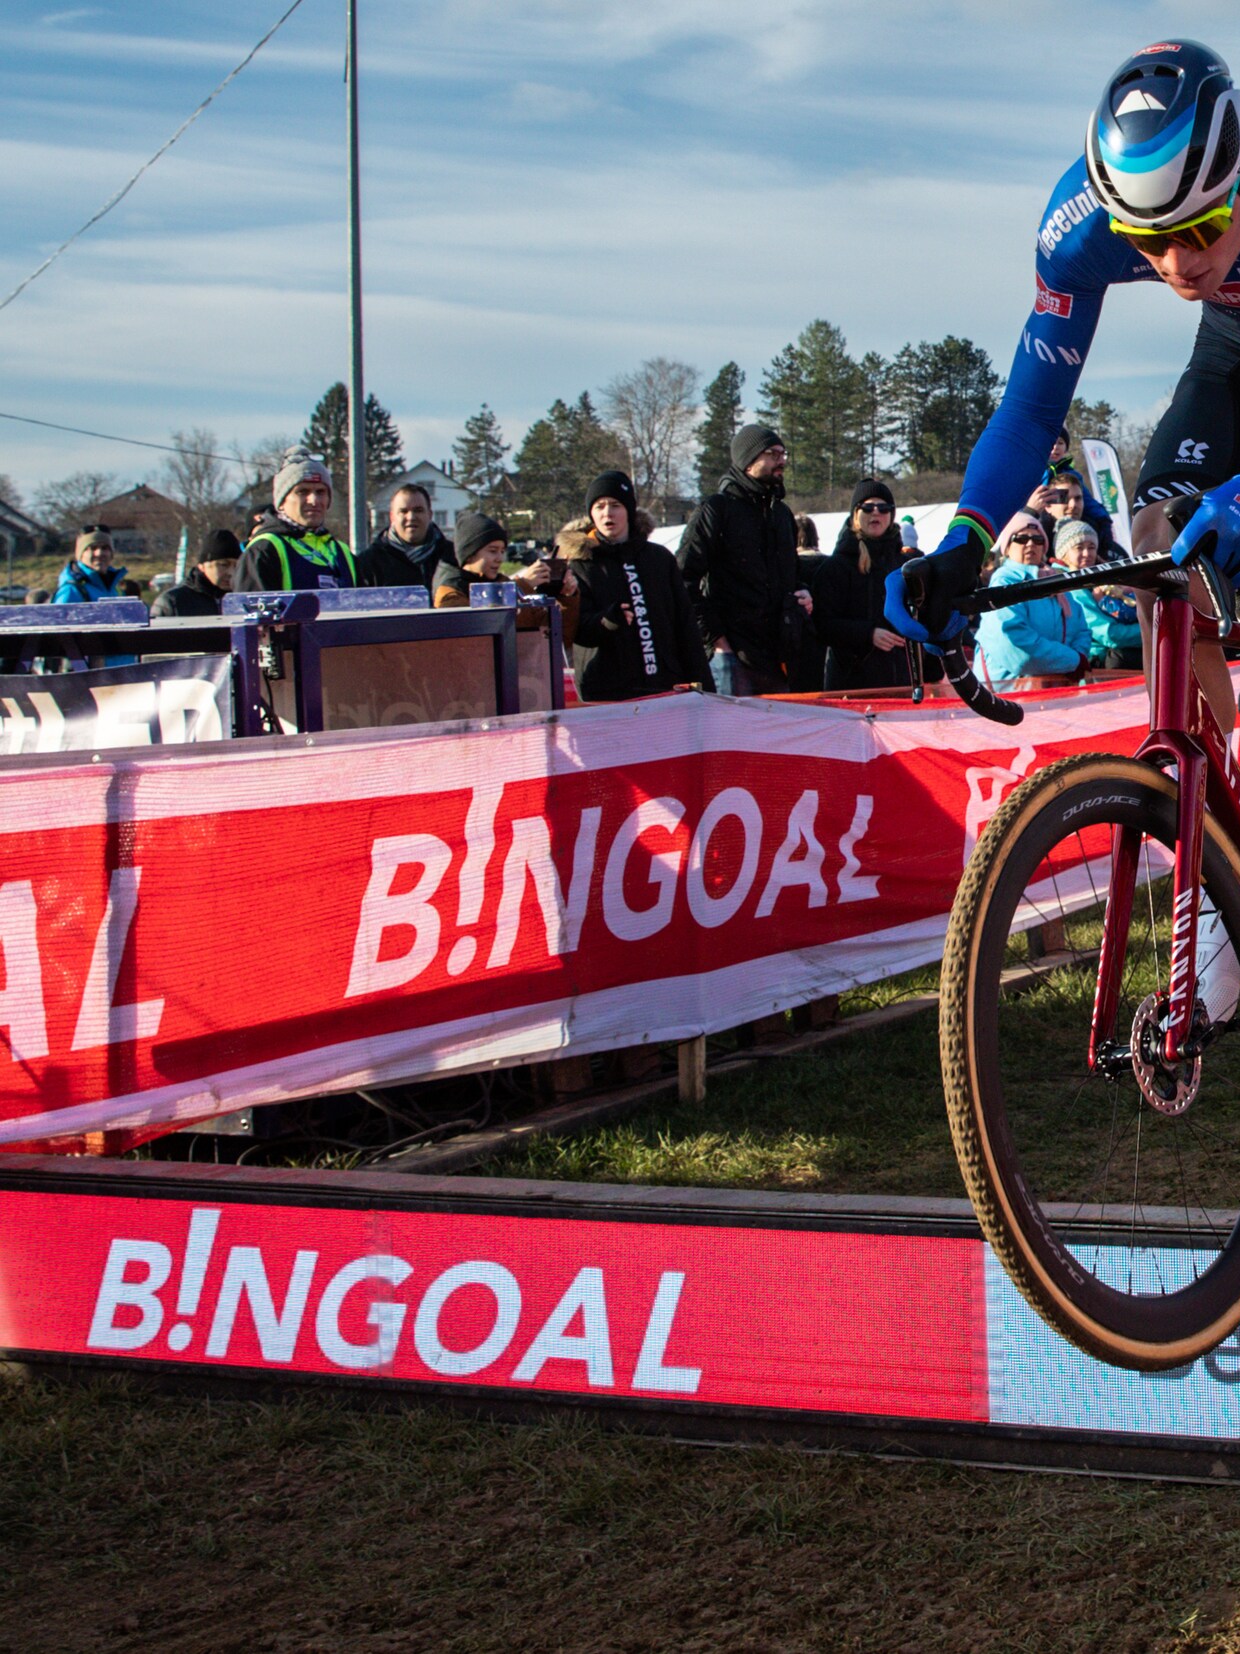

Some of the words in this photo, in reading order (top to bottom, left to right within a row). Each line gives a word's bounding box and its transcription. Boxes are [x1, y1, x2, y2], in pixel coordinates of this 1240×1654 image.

[622, 562, 658, 676] JACK&JONES
[1062, 795, 1142, 822] DURA-ACE
[1167, 887, 1193, 1028] CANYON
